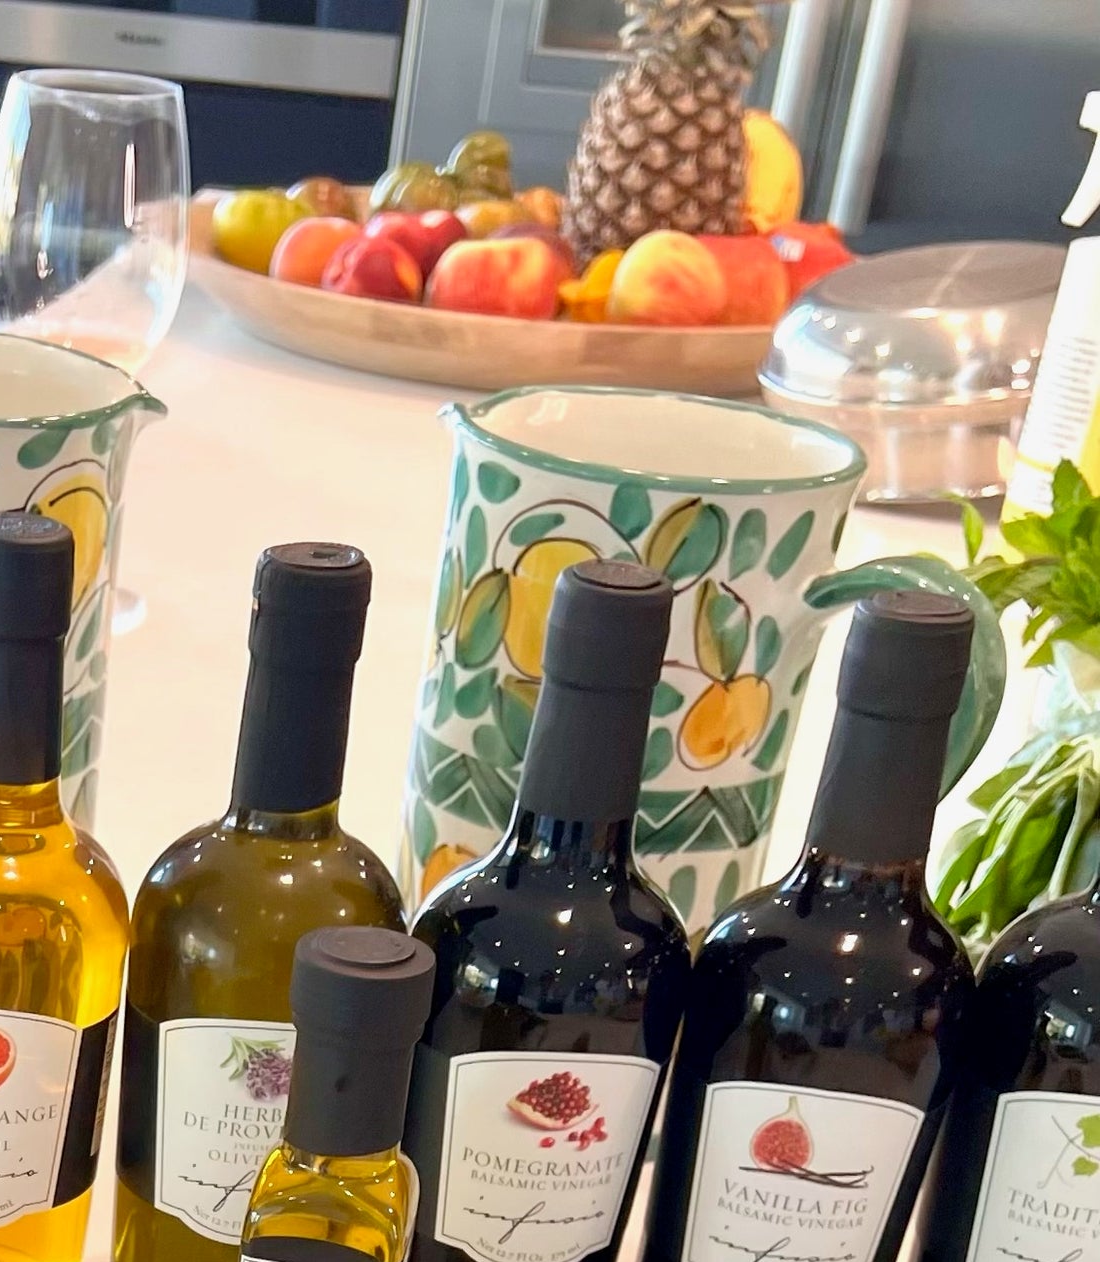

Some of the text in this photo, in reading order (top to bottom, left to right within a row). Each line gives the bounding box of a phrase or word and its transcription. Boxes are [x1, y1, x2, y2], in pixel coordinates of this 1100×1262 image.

[183, 1111, 284, 1140] DE PROV
[223, 1104, 282, 1123] HERB
[461, 1146, 625, 1177] POMEGRANATE
[470, 1170, 613, 1192] BALSAMIC VINEGAR
[723, 1178, 868, 1216] VANILLA FIG
[1008, 1186, 1100, 1225] TRADIT
[717, 1197, 864, 1231] BALSAMIC VINEGAR
